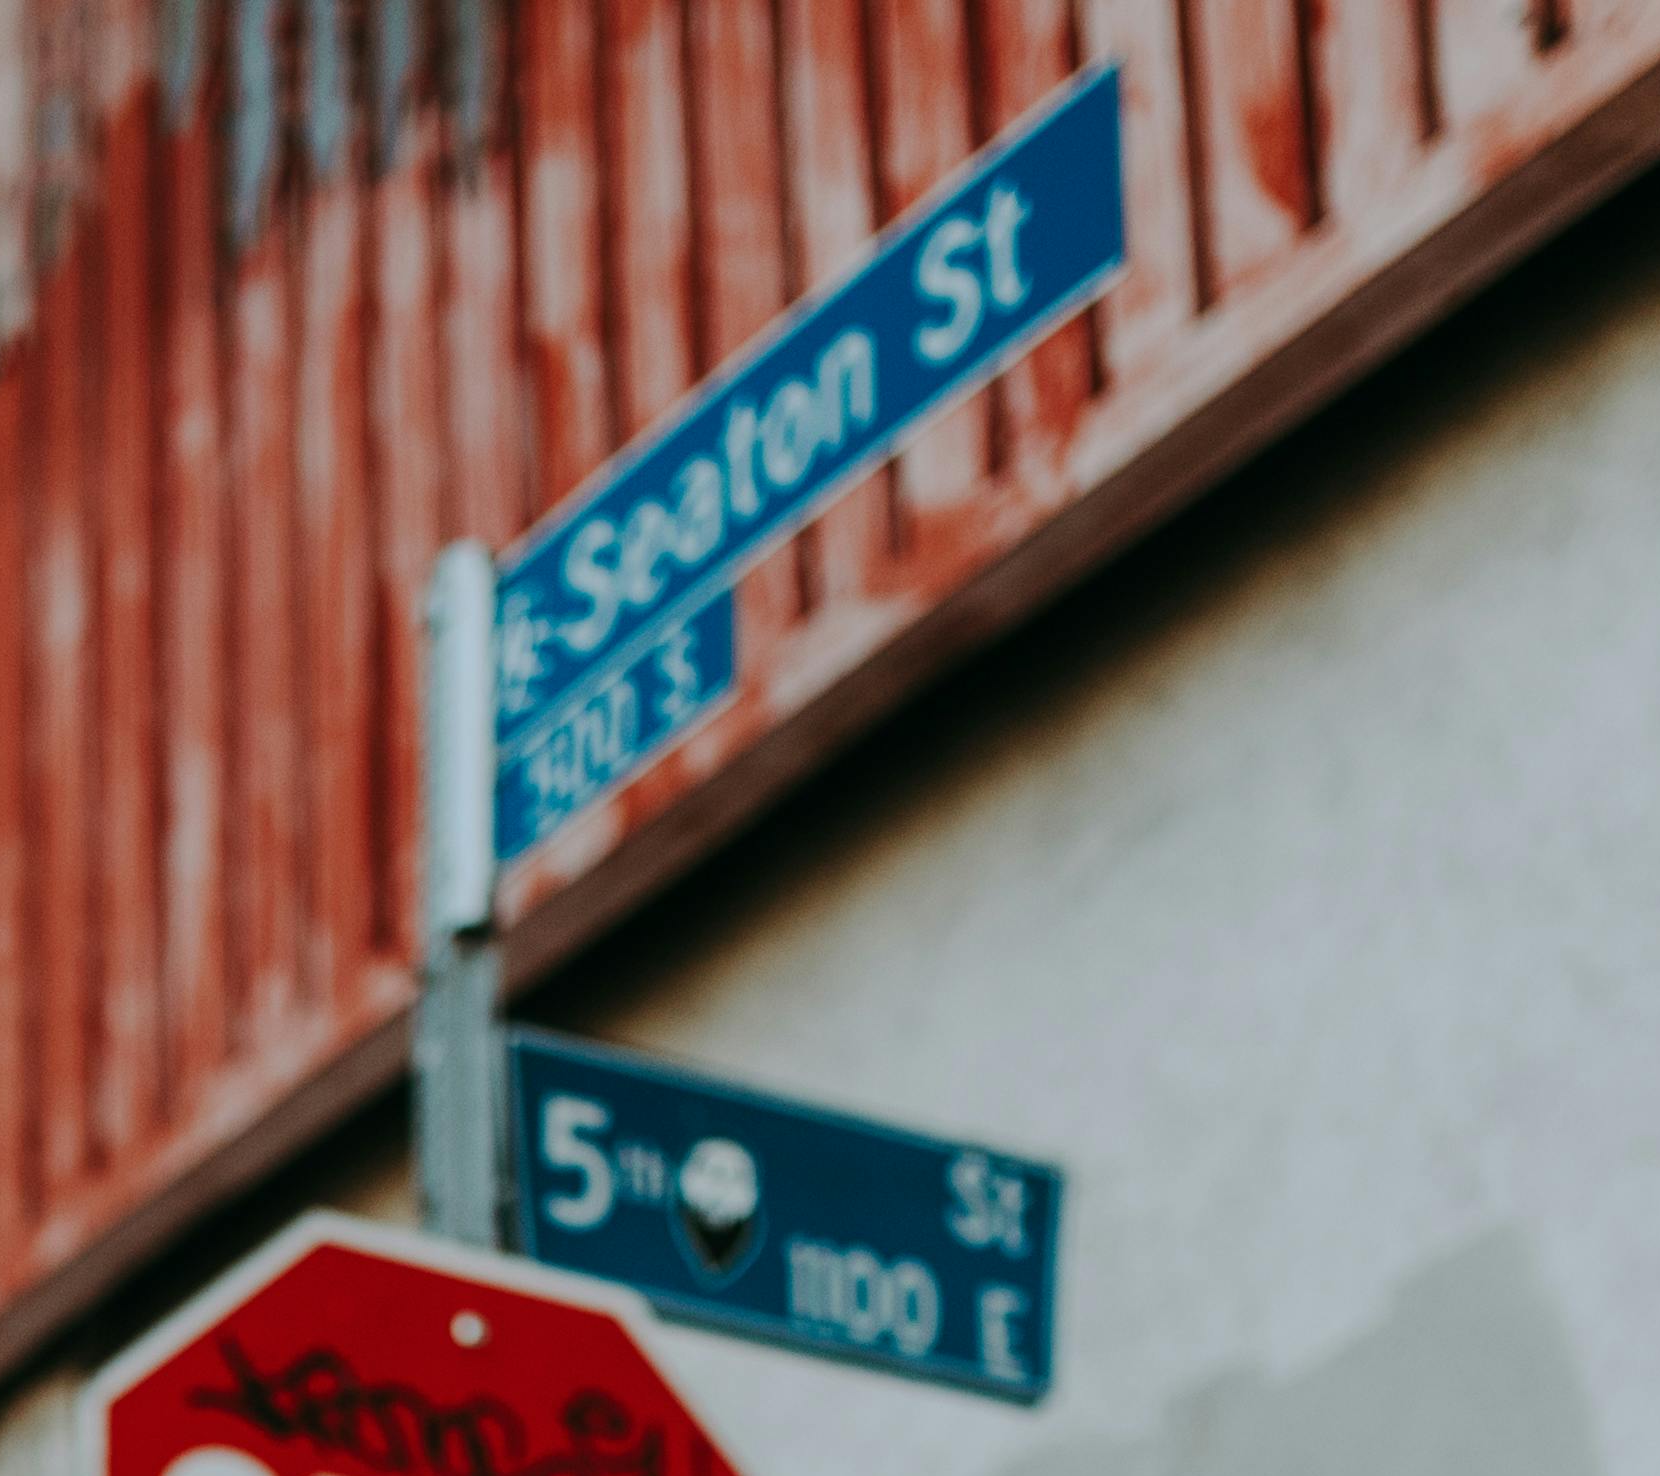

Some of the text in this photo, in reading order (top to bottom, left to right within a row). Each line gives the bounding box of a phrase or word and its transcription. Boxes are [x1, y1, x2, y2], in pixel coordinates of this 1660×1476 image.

[554, 323, 878, 654] Seaton
[910, 180, 1032, 366] St
[946, 1149, 1028, 1259] St
